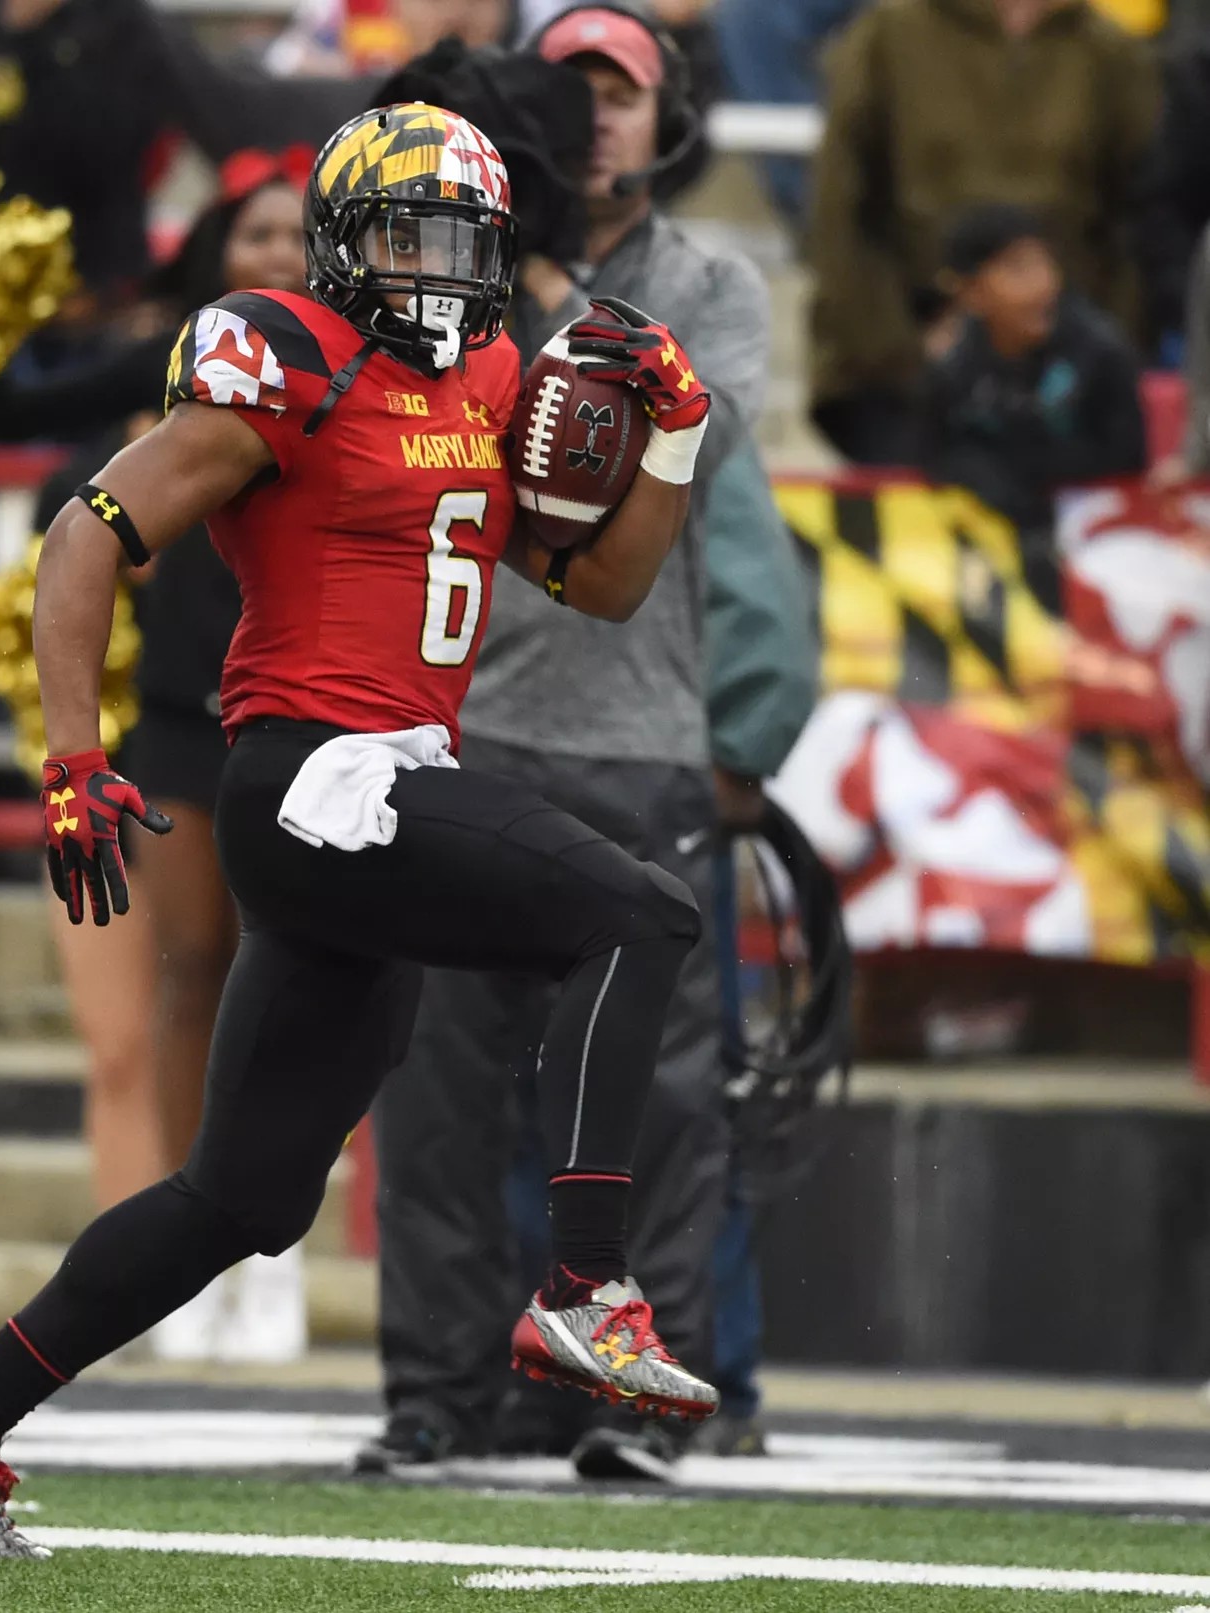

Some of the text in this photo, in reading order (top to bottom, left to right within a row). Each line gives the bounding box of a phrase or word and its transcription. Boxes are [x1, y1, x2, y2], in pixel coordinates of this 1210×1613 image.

[439, 180, 460, 200] M
[400, 434, 502, 469] MARYLAND
[420, 489, 488, 668] 6
